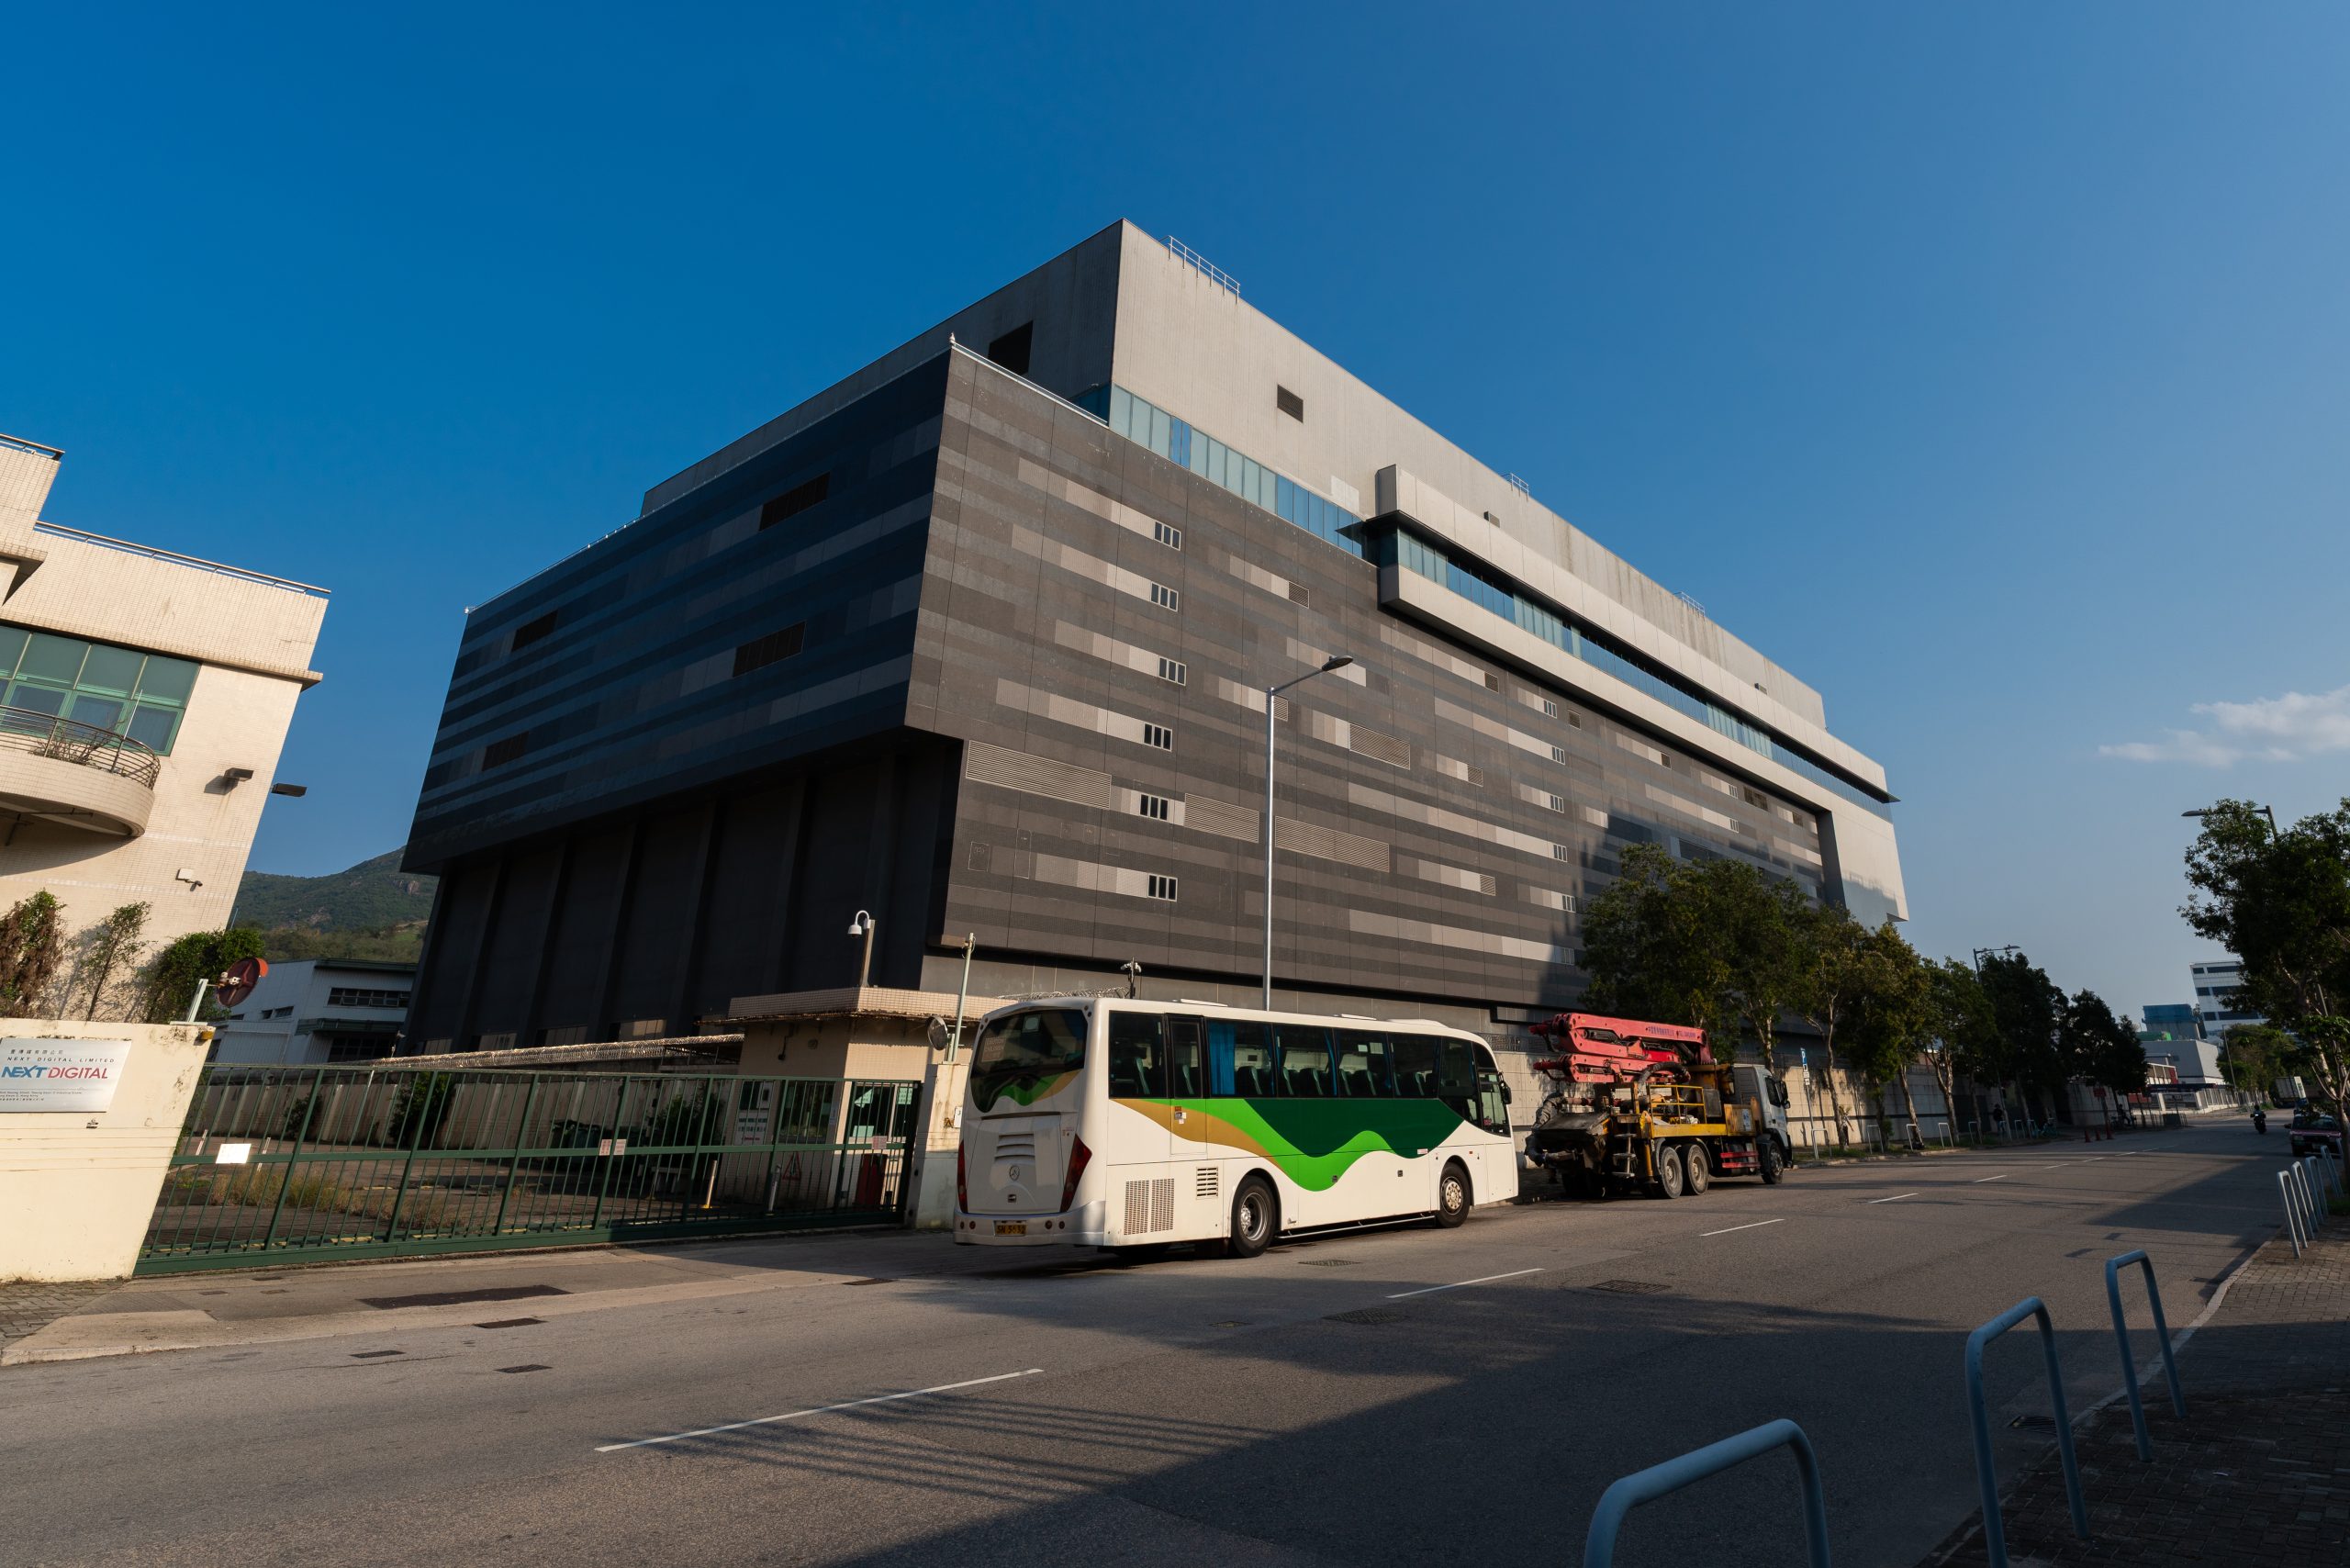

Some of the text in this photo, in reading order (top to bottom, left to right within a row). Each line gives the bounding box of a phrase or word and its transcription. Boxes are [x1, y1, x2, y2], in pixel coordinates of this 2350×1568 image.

[1, 1065, 108, 1079] NEXT DIGITAL
[997, 1225, 1006, 1234] SN
